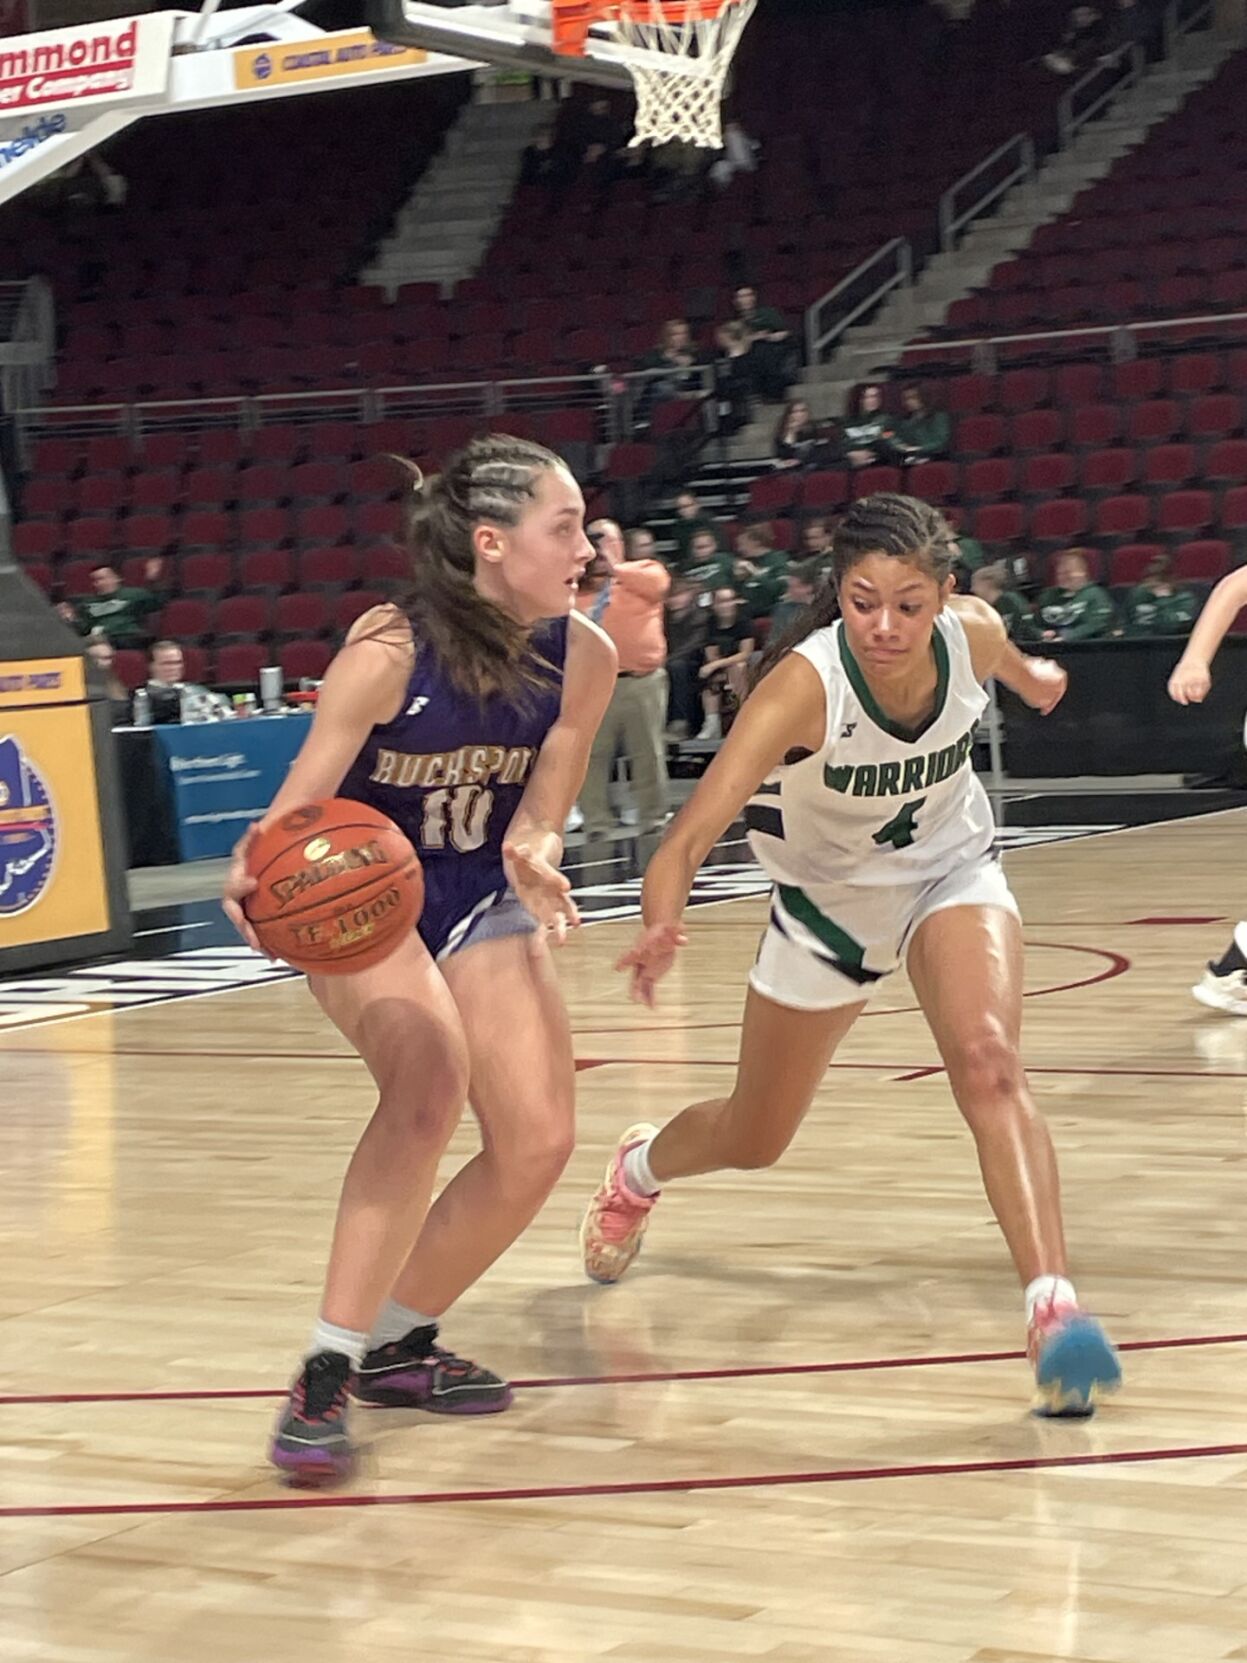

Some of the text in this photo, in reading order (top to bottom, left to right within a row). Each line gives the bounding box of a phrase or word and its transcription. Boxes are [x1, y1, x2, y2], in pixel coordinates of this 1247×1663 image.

[0, 20, 137, 78] mmond
[369, 745, 537, 788] BUCKSPO
[823, 717, 980, 797] WARRIOR
[420, 784, 495, 853] 10
[872, 796, 927, 850] 4
